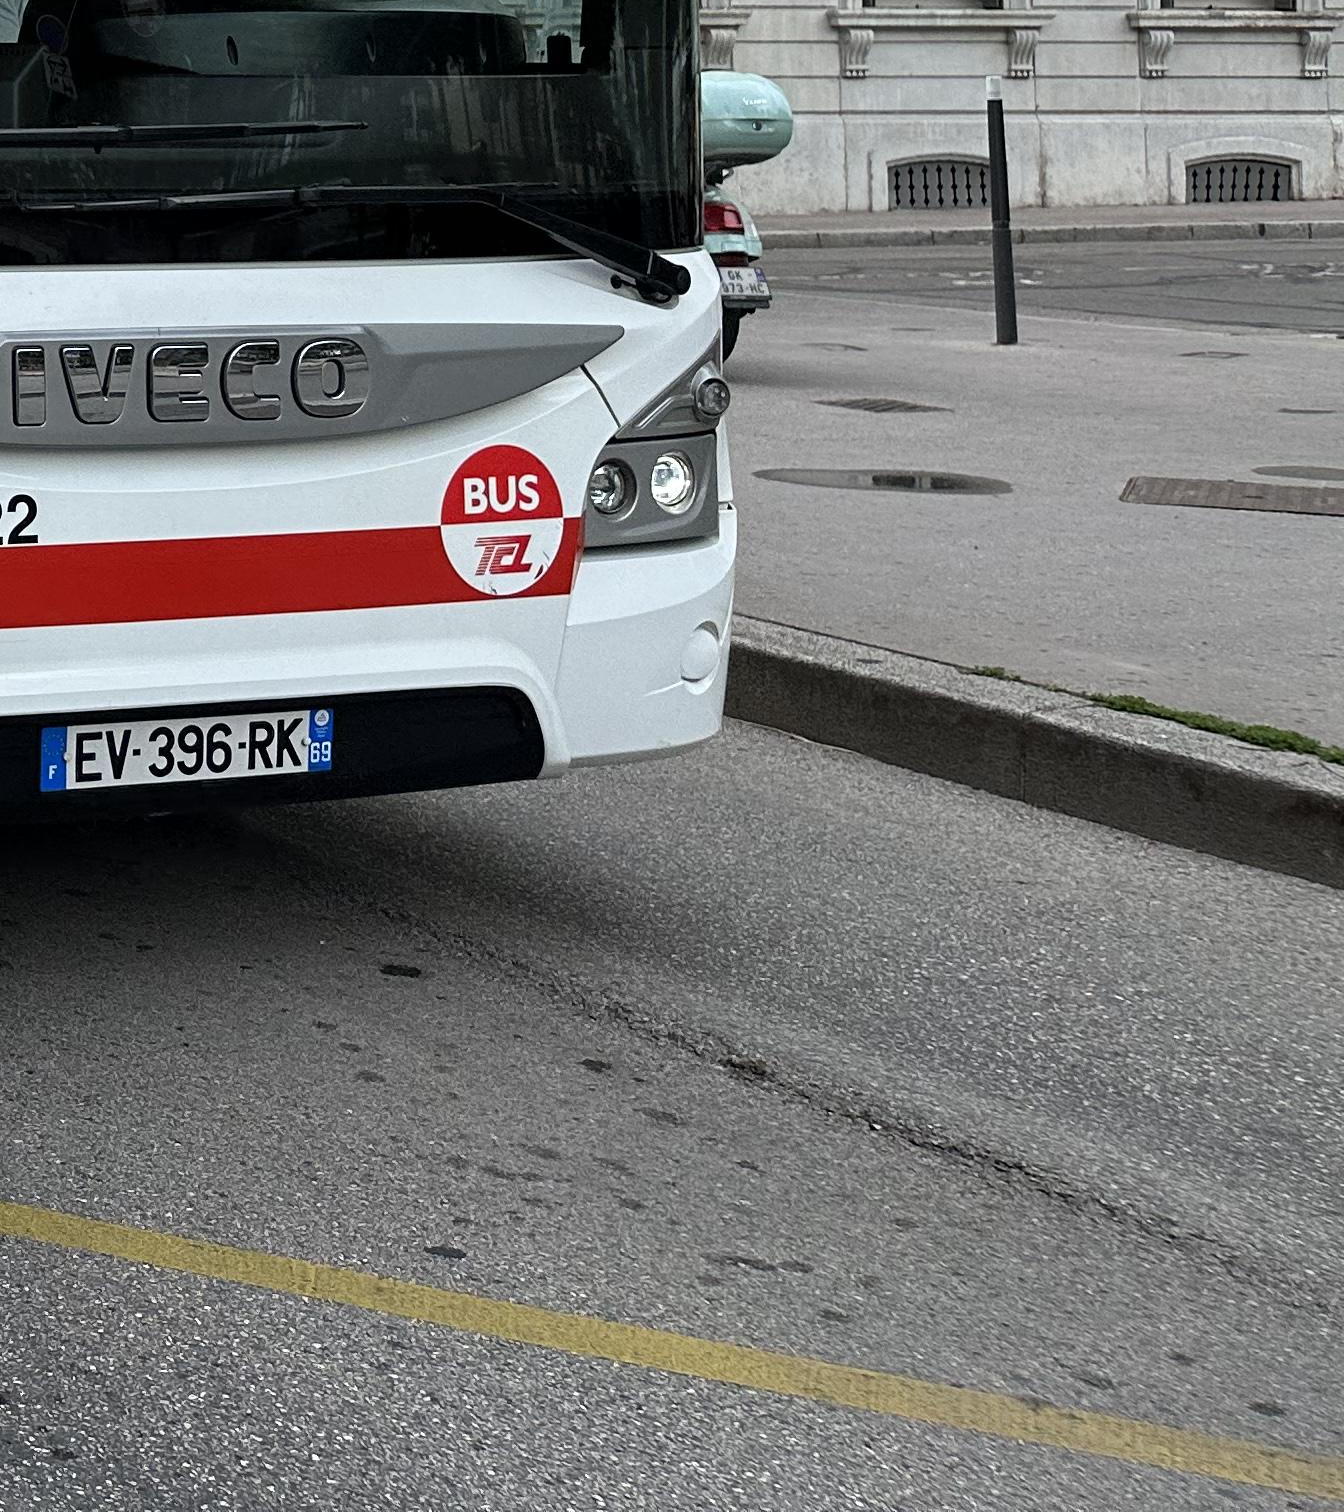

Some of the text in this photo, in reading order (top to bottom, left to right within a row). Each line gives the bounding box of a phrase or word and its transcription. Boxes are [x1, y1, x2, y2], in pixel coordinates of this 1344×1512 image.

[12, 338, 369, 427] IVECO
[464, 474, 540, 515] BUS
[48, 765, 57, 779] F
[75, 718, 304, 783] EV-396-RK
[310, 741, 332, 763] 69
